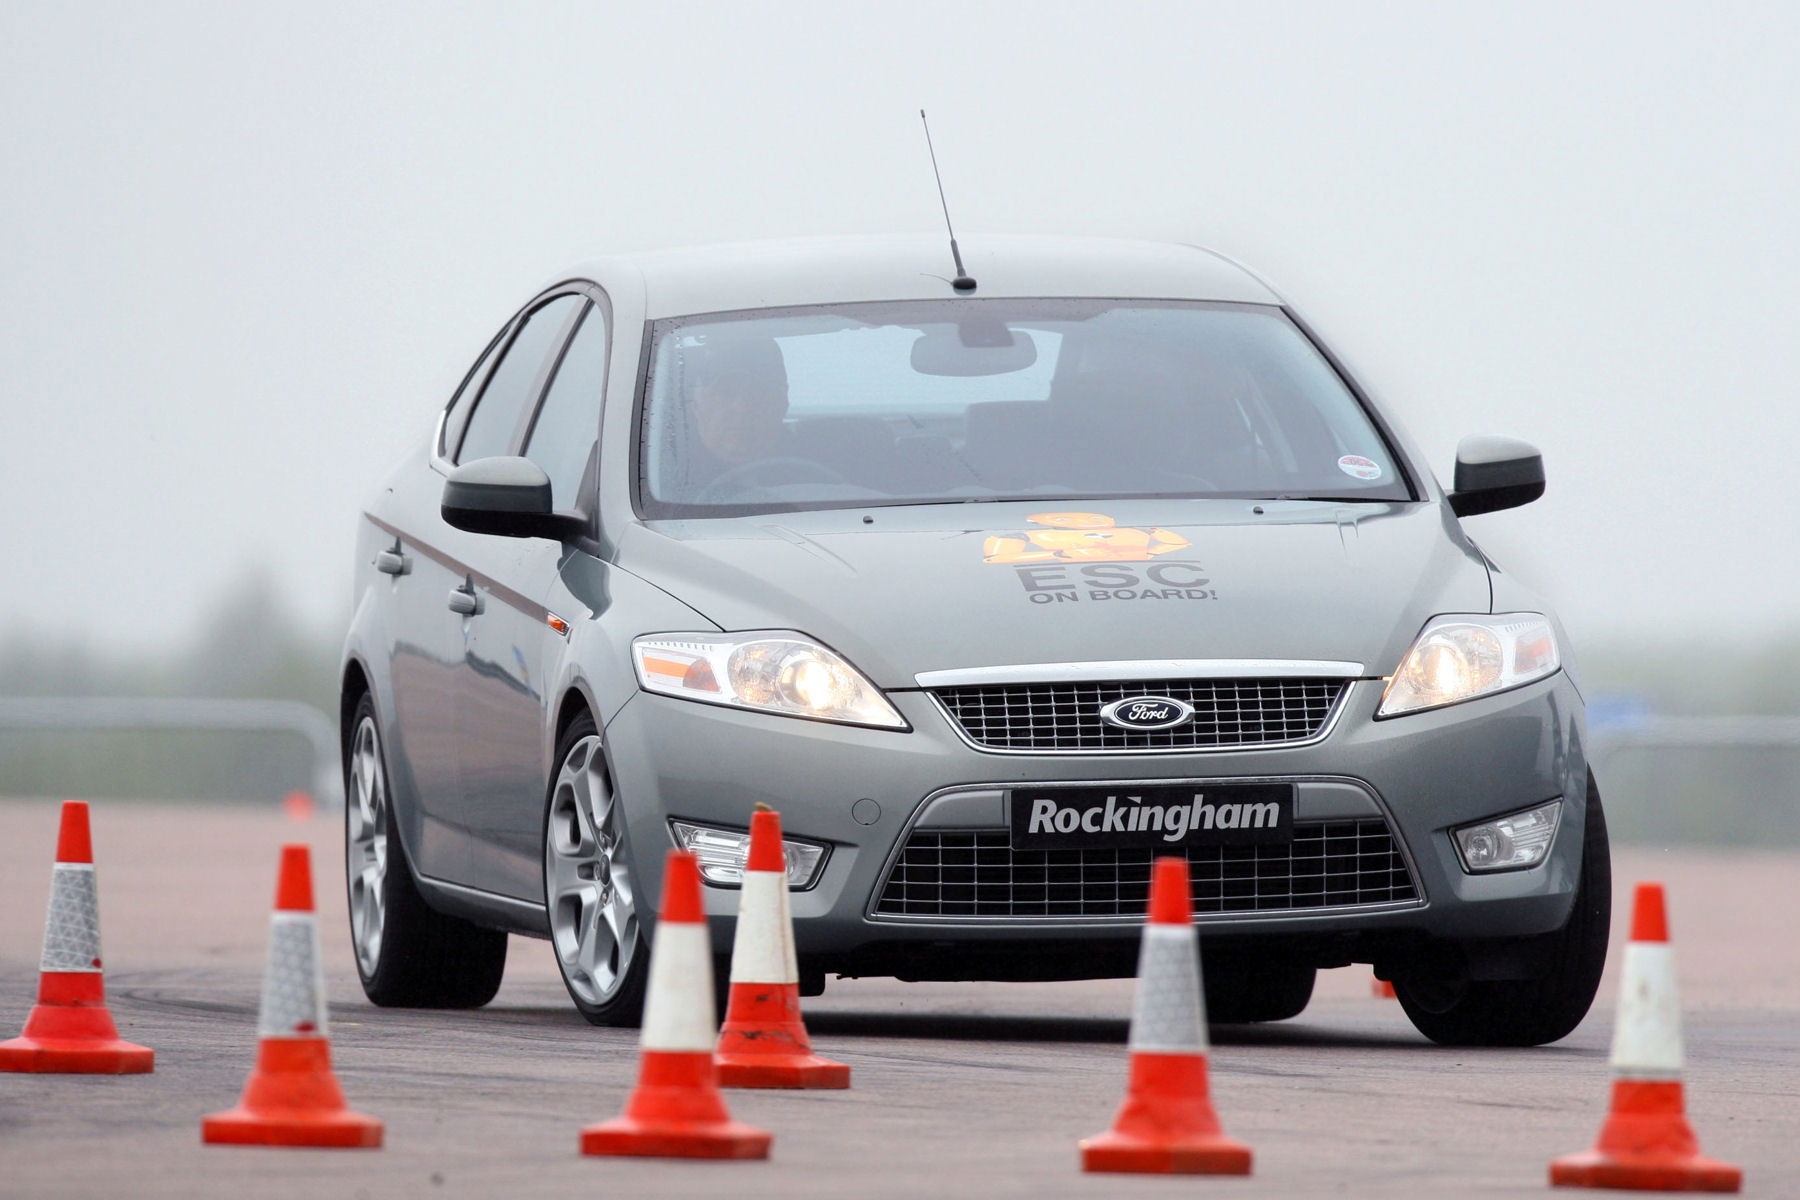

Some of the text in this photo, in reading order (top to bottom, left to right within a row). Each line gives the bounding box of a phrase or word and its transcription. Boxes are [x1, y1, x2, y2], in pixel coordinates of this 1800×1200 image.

[1015, 563, 1210, 592] ESC
[1029, 589, 1218, 604] ON BOARD!
[1128, 703, 1168, 721] Ford
[1028, 794, 1280, 842] Rockingham
